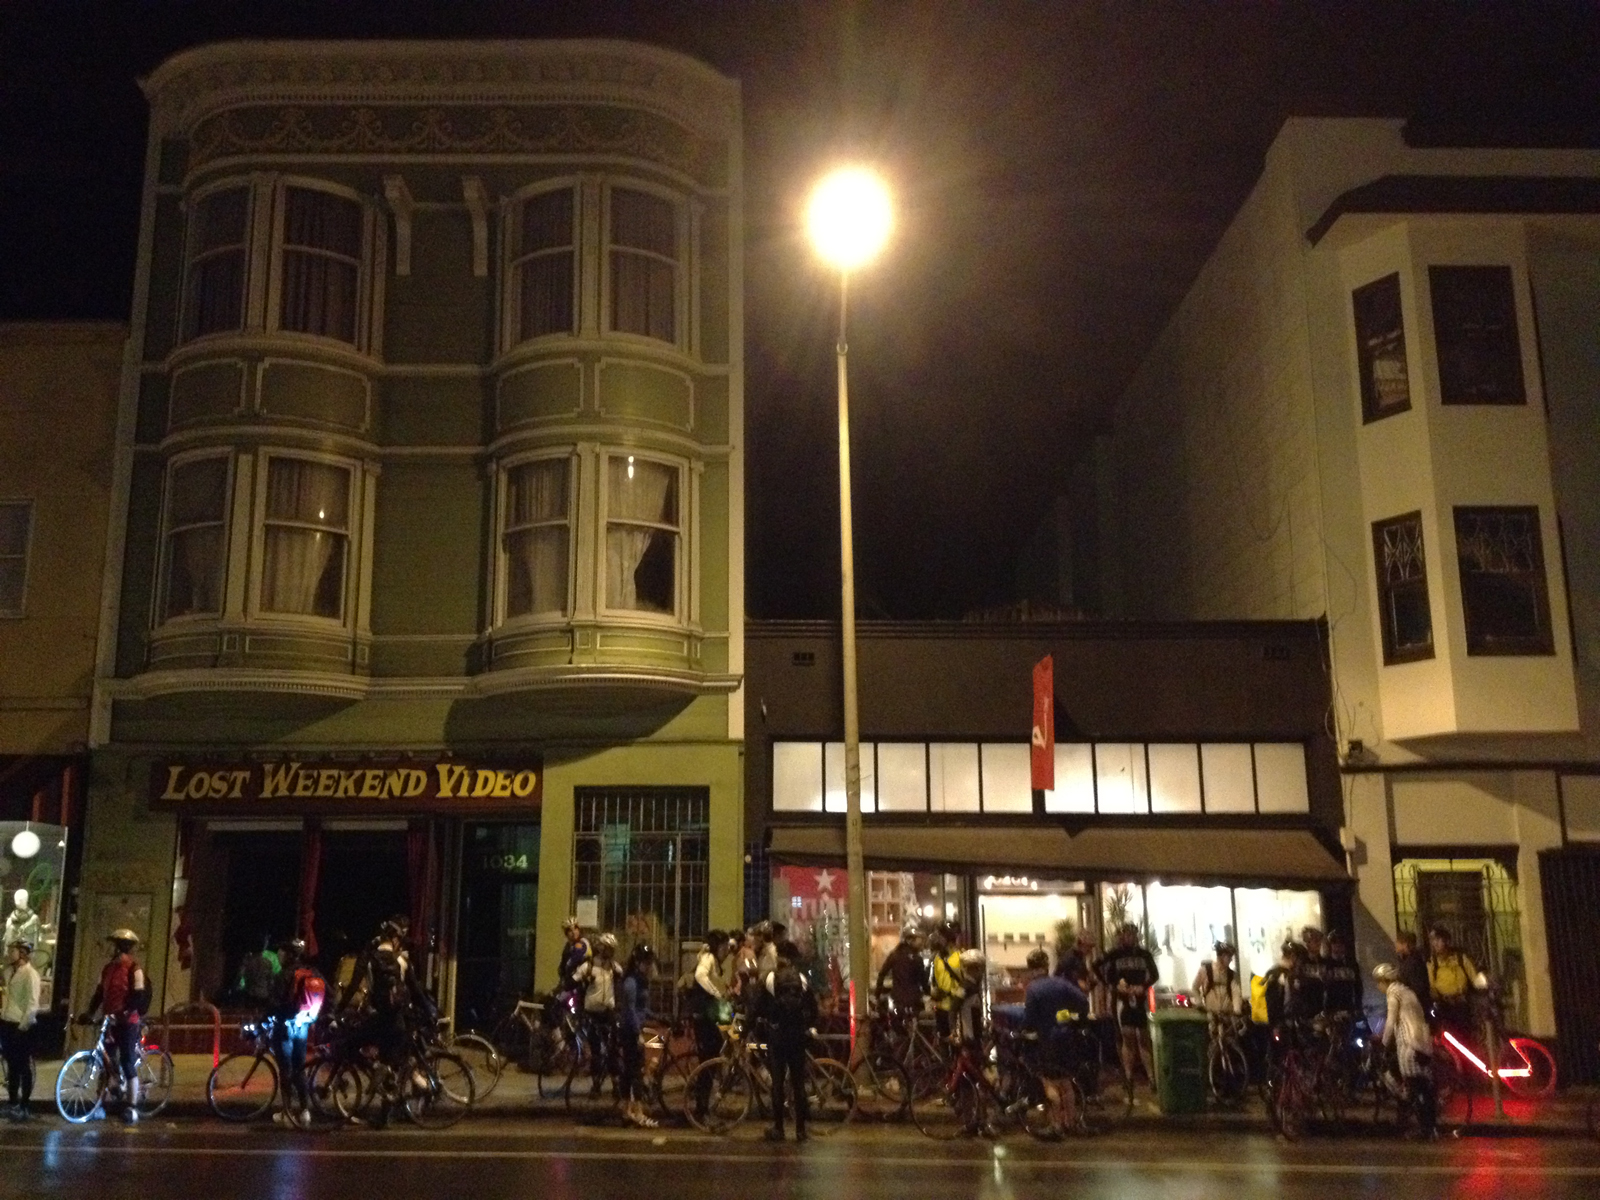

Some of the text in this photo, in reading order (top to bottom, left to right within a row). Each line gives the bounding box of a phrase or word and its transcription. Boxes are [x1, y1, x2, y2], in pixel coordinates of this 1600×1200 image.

[160, 765, 250, 801] LOST
[257, 762, 428, 800] WEEKEND
[482, 854, 529, 869] 1034
